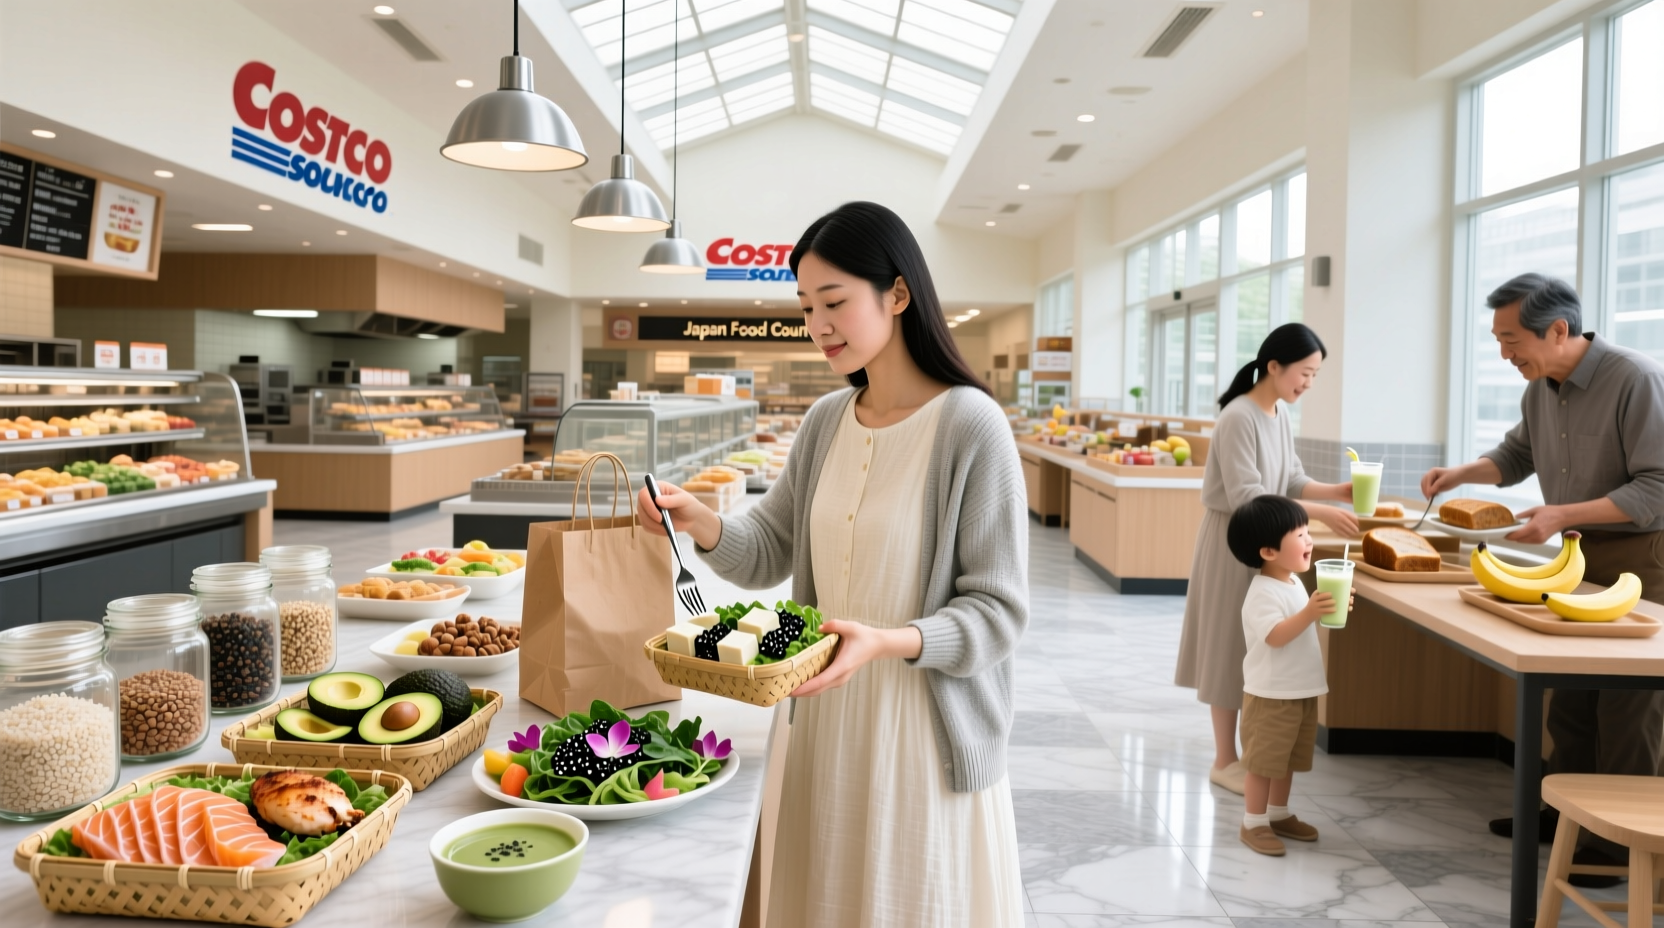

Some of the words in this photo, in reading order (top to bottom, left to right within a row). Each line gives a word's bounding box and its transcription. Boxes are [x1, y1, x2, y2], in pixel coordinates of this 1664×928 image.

[233, 61, 392, 184] COSTCO
[706, 238, 794, 266] COST
[683, 321, 727, 341] Japan
[731, 321, 768, 337] Food
[770, 321, 809, 338] Coun
